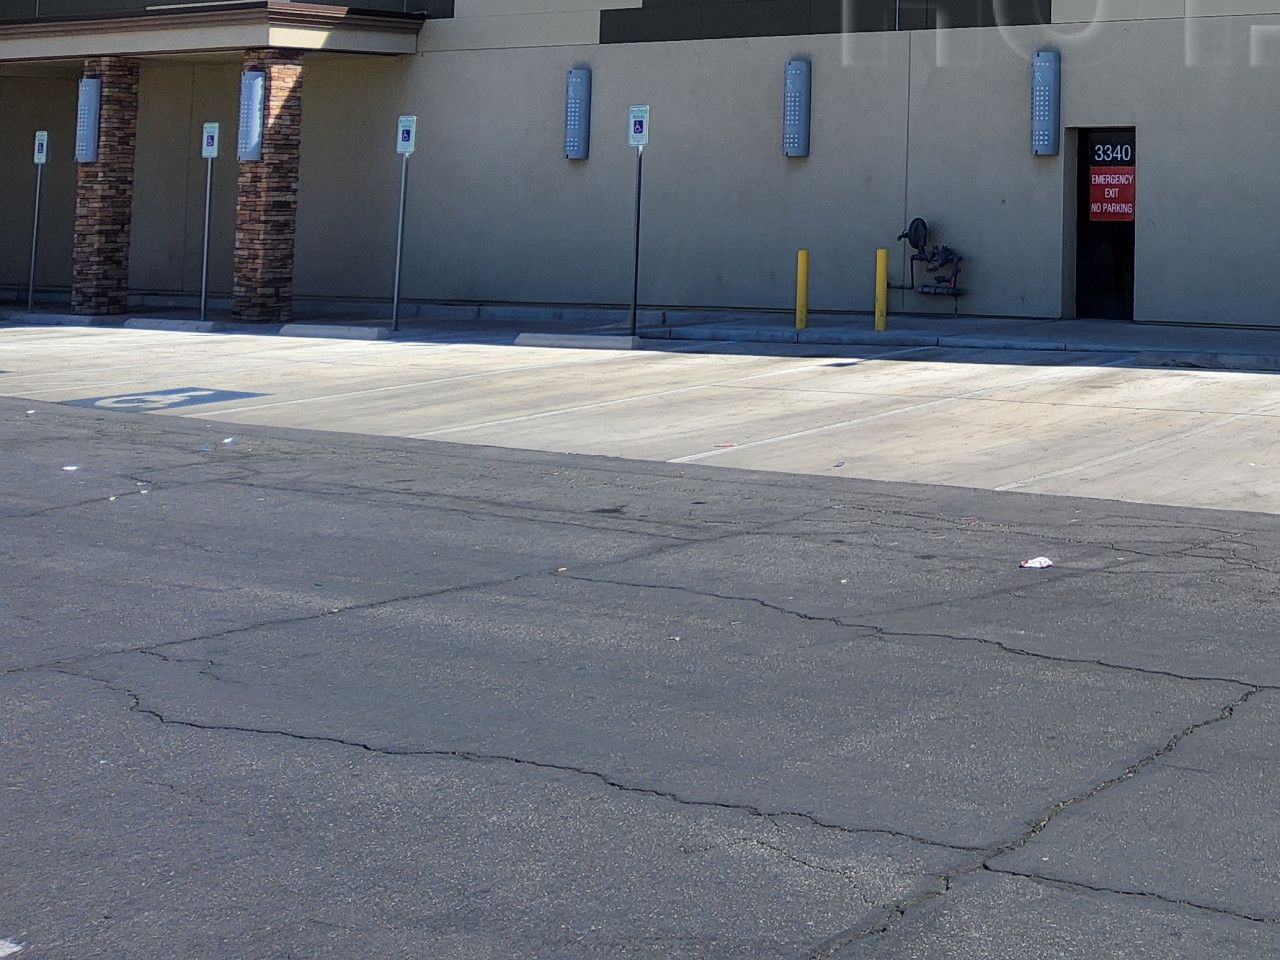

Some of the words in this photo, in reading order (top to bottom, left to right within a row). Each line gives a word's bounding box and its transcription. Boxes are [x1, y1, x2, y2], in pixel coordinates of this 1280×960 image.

[1094, 144, 1132, 161] 3340
[1091, 174, 1134, 185] EMERGENCY
[1104, 187, 1120, 198] EXIT
[1091, 202, 1102, 213] NO
[1102, 202, 1133, 214] PARKING
